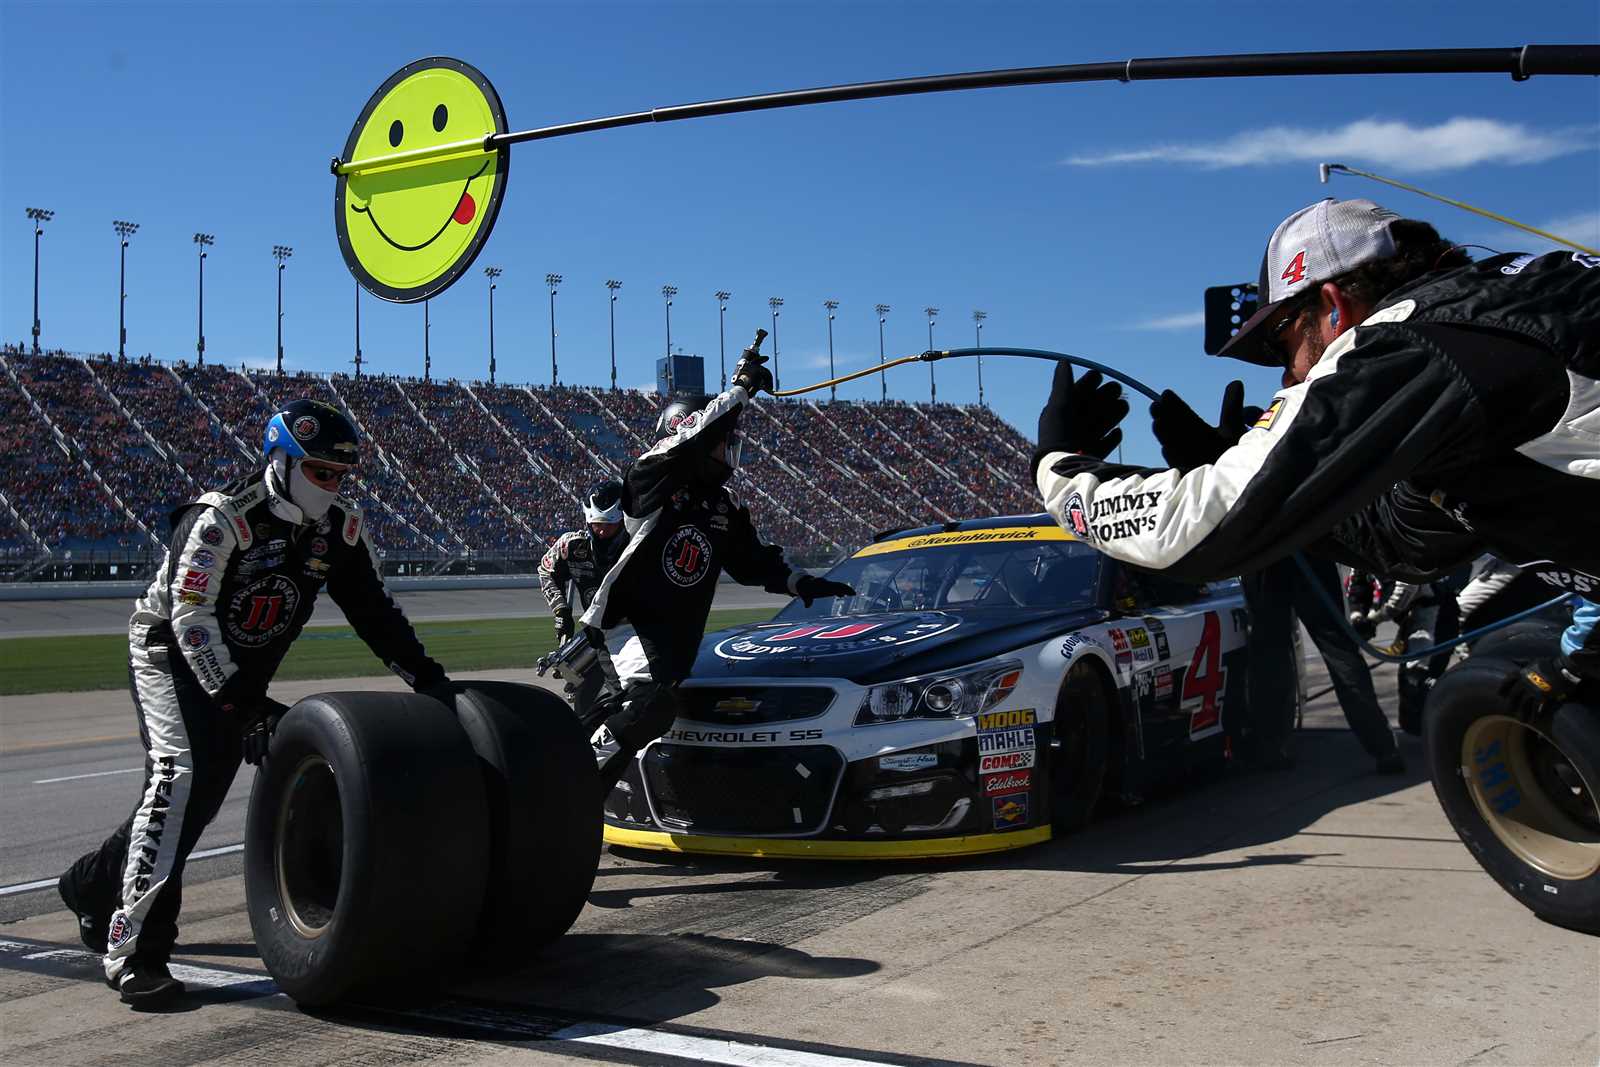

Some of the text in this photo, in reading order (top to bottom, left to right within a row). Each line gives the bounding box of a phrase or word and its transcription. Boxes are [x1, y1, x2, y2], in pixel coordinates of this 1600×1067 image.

[1281, 251, 1308, 285] 4
[1089, 490, 1162, 522] JIMMY
[907, 530, 1038, 548] @KevinHarvick
[1090, 514, 1157, 545] JOHN'S
[240, 594, 284, 631] JJ
[1180, 611, 1227, 742] 4
[978, 710, 1035, 731] MOOG
[789, 729, 823, 741] SS
[980, 730, 1034, 752] MAHLE
[981, 752, 1022, 770] COMP
[986, 776, 1031, 792] Edelbrock
[146, 756, 175, 847] FREAKY
